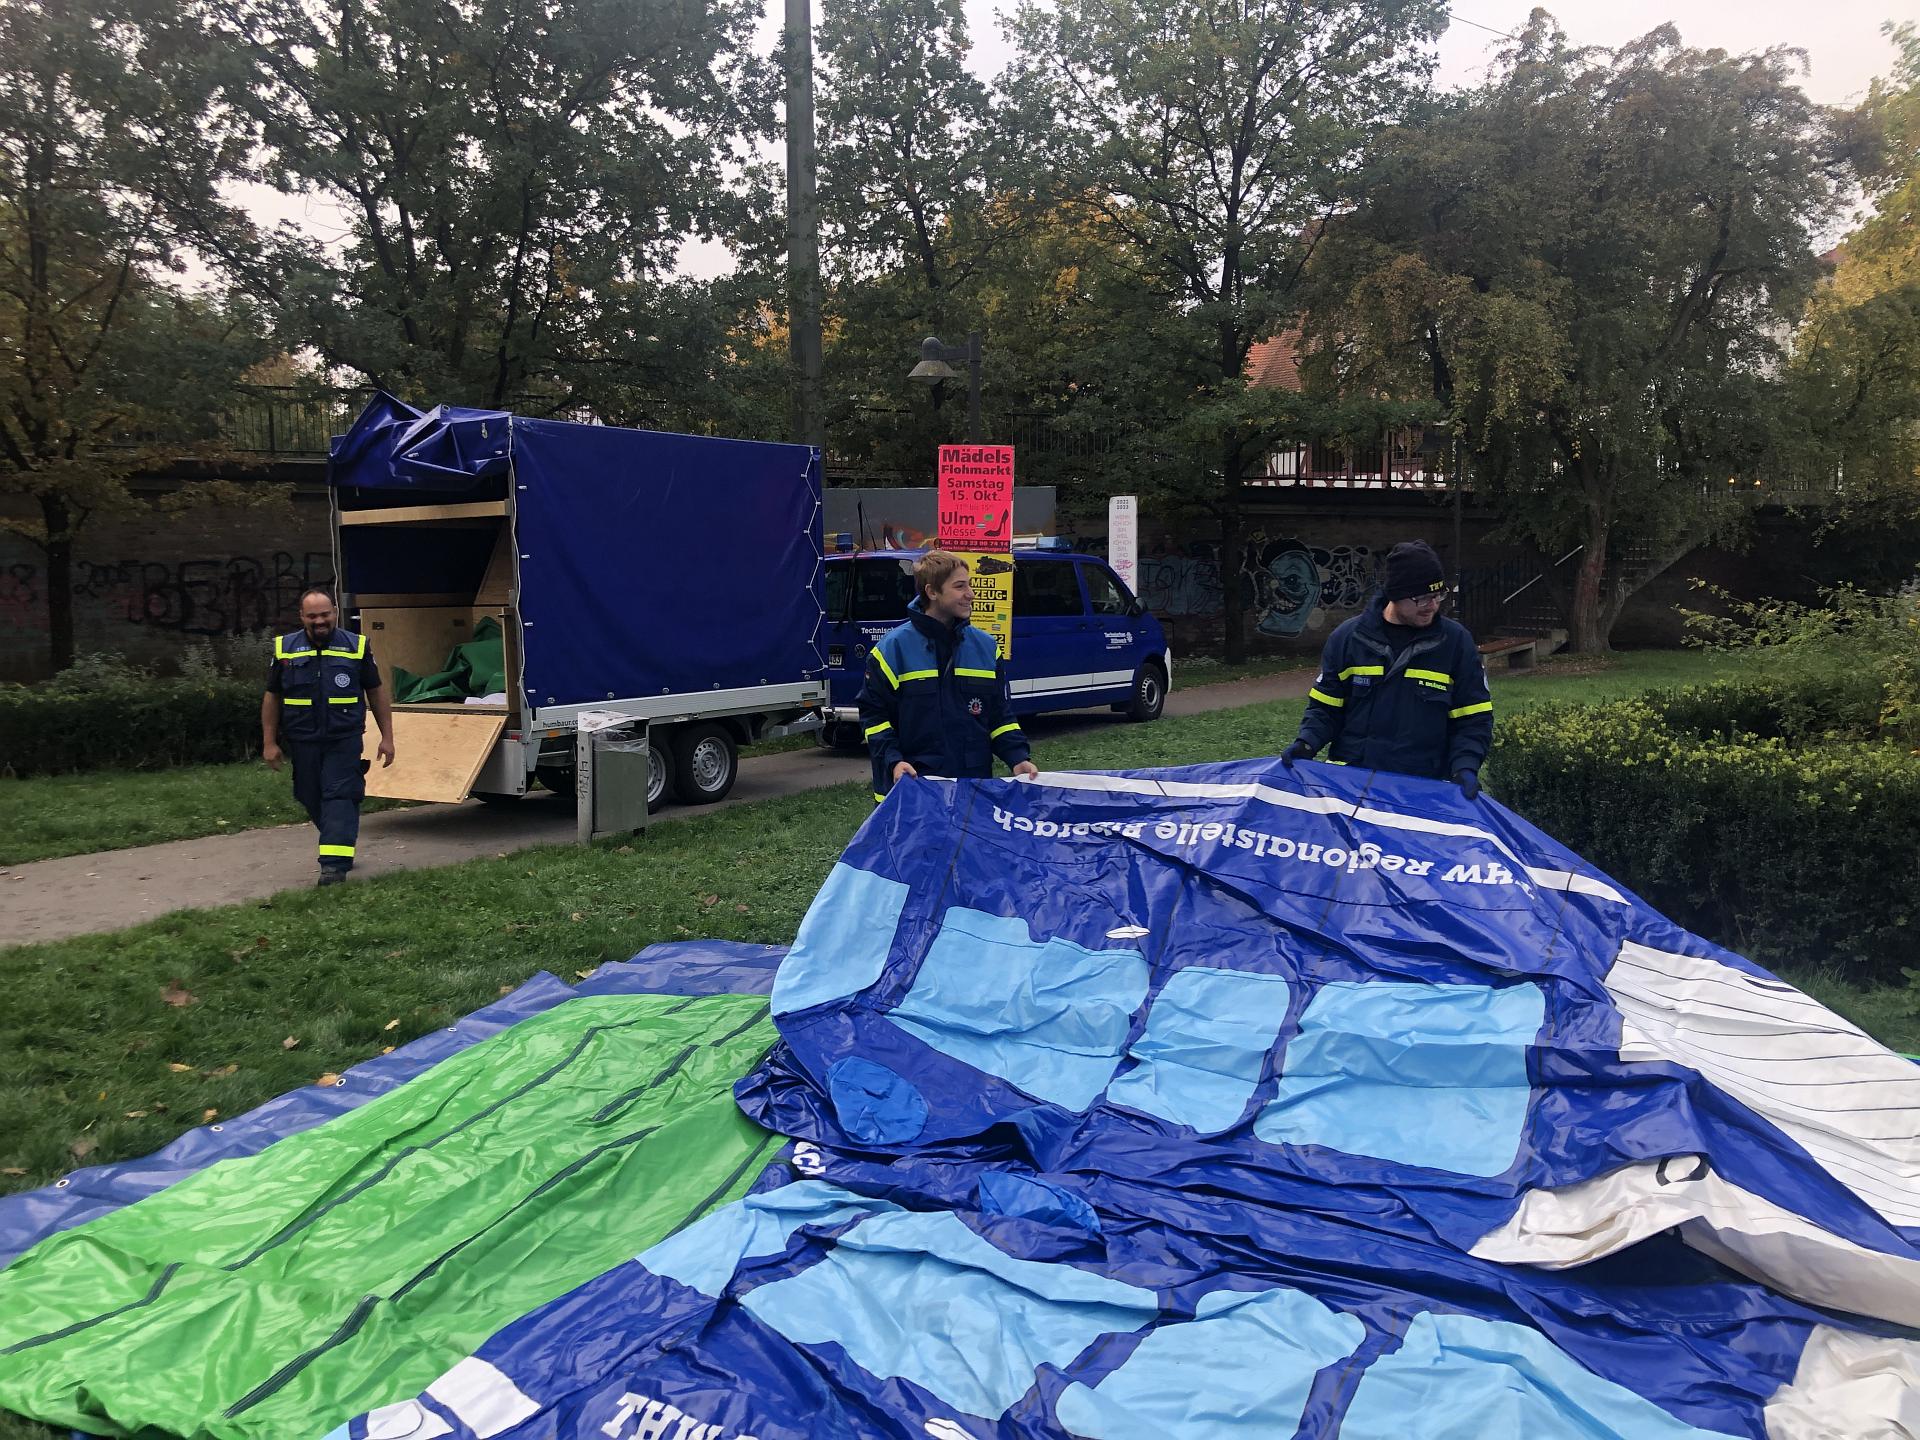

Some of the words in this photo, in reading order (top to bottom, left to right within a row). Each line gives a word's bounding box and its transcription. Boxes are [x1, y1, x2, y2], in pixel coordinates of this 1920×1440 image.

[942, 448, 1011, 463] Mädels
[941, 464, 1011, 476] Flohmarkt
[947, 478, 1004, 491] Samstag
[950, 490, 969, 501] 15.
[973, 490, 1001, 502] Okt.
[941, 511, 975, 525] Ulm
[941, 526, 977, 537] Messe
[971, 578, 995, 588] MER
[974, 590, 1007, 600] ZEUG-
[542, 719, 579, 728] humbaur.co
[1154, 820, 1435, 877] Regionalstelle
